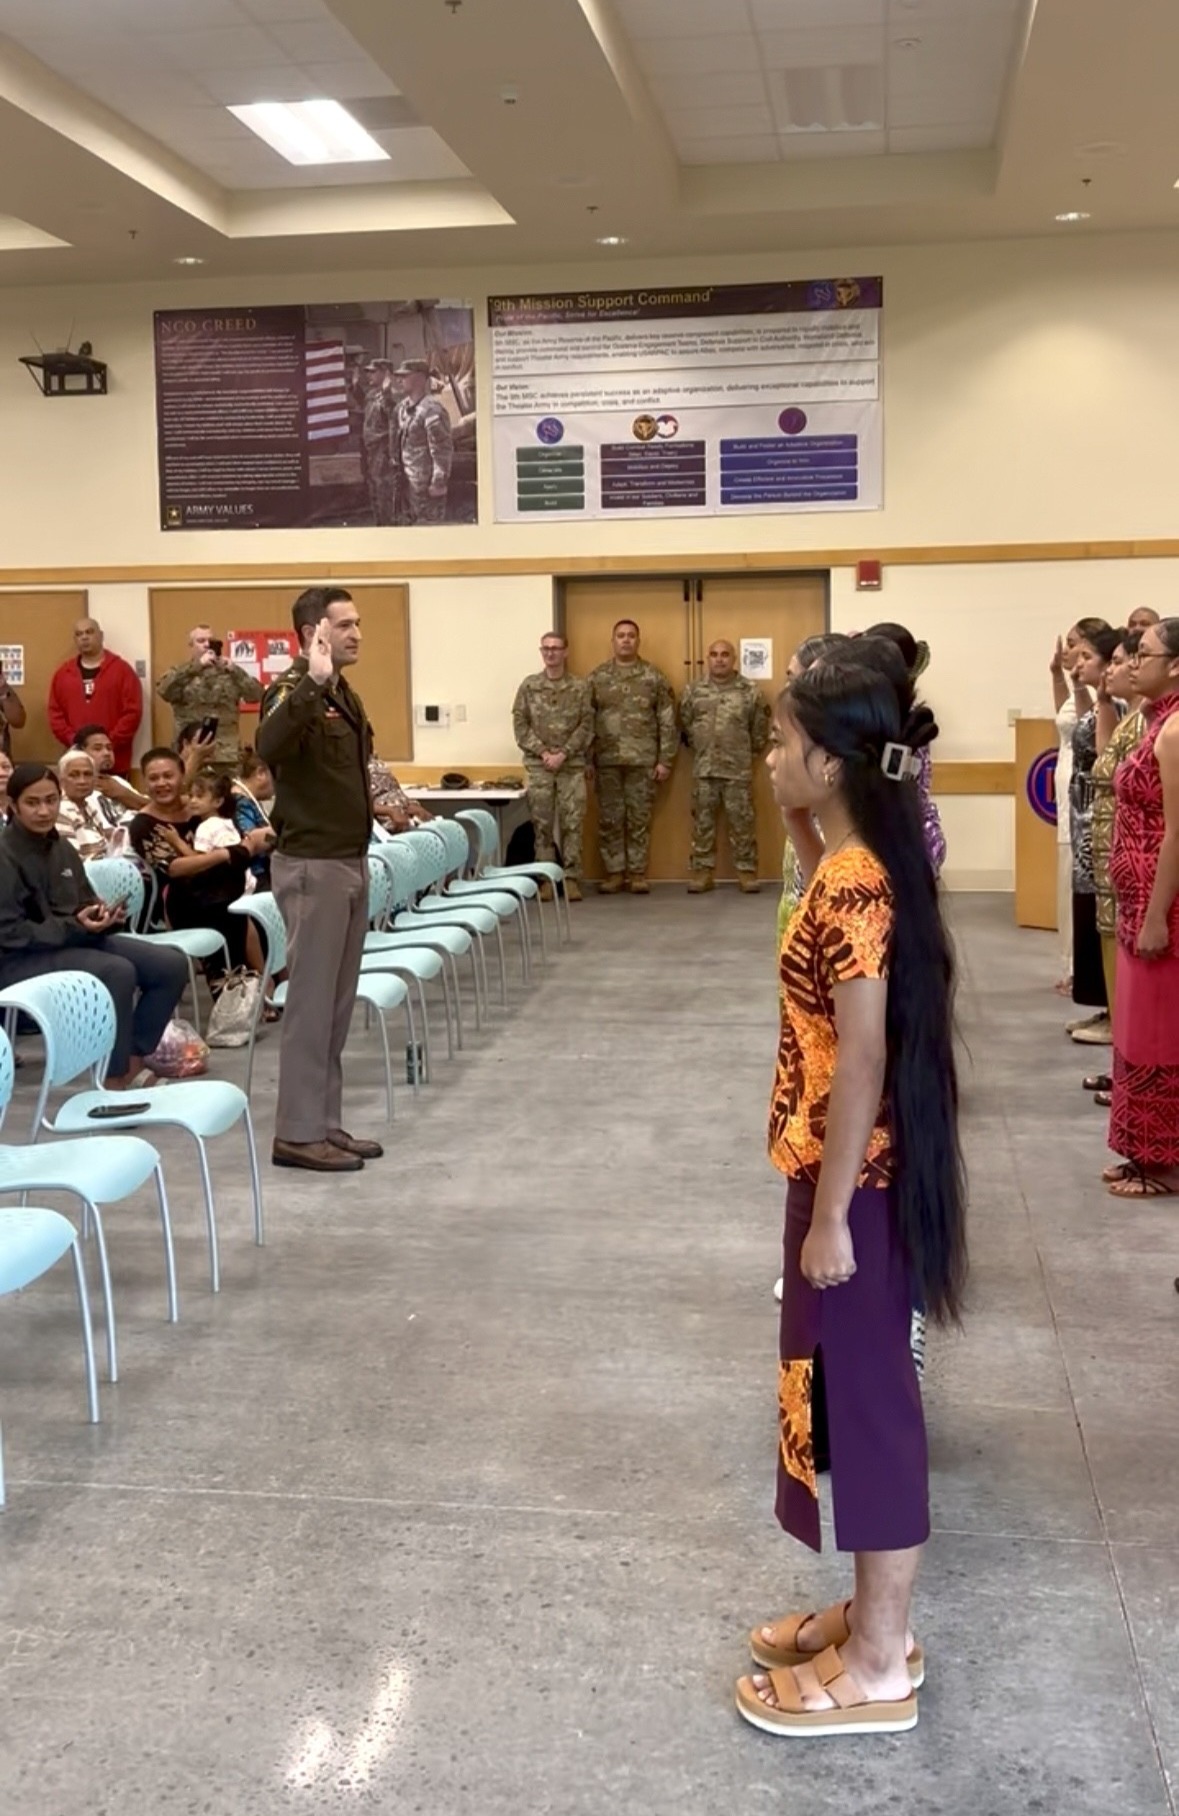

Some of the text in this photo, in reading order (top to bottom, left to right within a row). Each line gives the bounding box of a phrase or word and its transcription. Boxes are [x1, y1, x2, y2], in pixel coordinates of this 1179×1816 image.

[494, 289, 710, 312] 9th Mission Support Command
[161, 318, 257, 333] NCO CREED
[185, 503, 254, 516] ARMY VALUES
